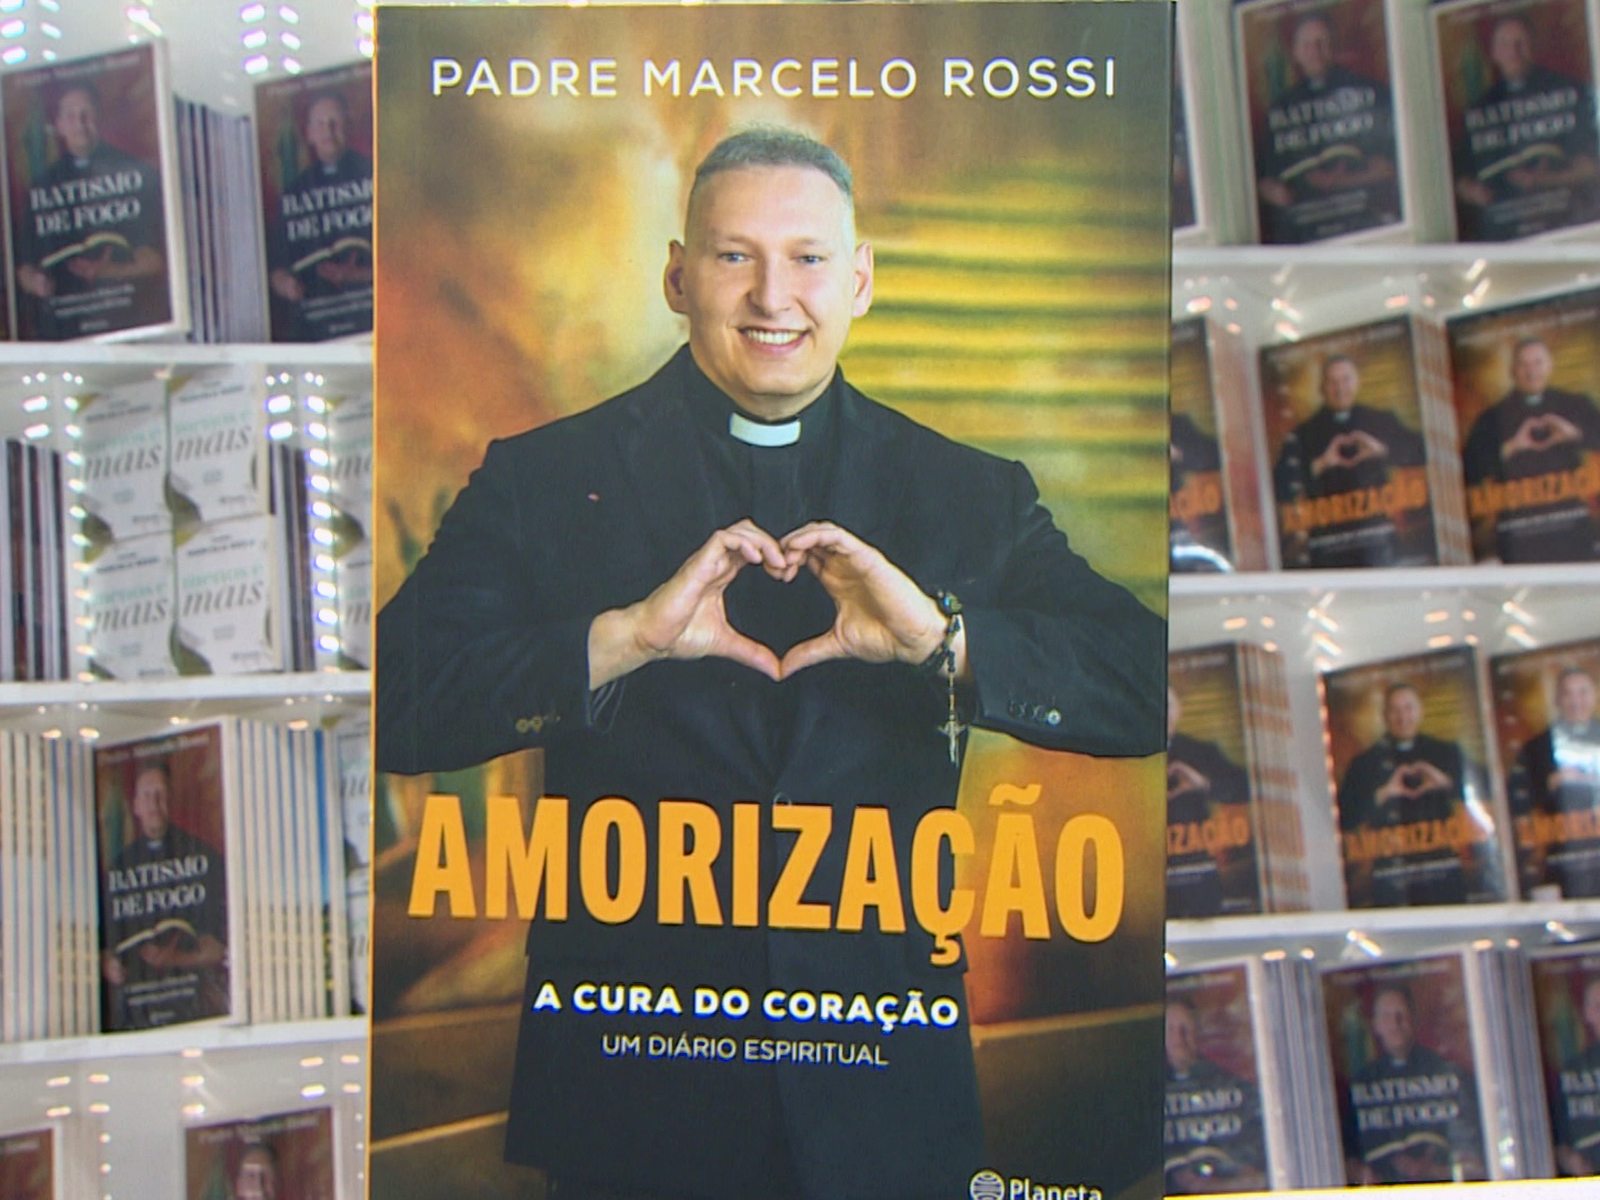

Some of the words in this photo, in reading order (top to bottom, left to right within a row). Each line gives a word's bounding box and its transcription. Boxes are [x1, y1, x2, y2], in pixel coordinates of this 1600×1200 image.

[431, 58, 618, 97] PADRE
[643, 58, 917, 99] MARCELO
[943, 57, 1116, 98] ROSSI
[282, 178, 372, 215] BATISM
[322, 203, 372, 236] FOG
[108, 854, 208, 893] BATISMO
[406, 783, 1126, 965] AMORIZAÇÃO
[146, 883, 206, 913] FOGO
[533, 981, 562, 1012] A
[572, 984, 682, 1016] CURA
[694, 988, 751, 1018] DO
[762, 989, 960, 1033] CORAÇÃO
[602, 1035, 641, 1057] UM
[648, 1031, 738, 1061] DIÁRIO
[743, 1038, 889, 1067] ESPIRITUAL
[1009, 1177, 1103, 1200] Planeta
